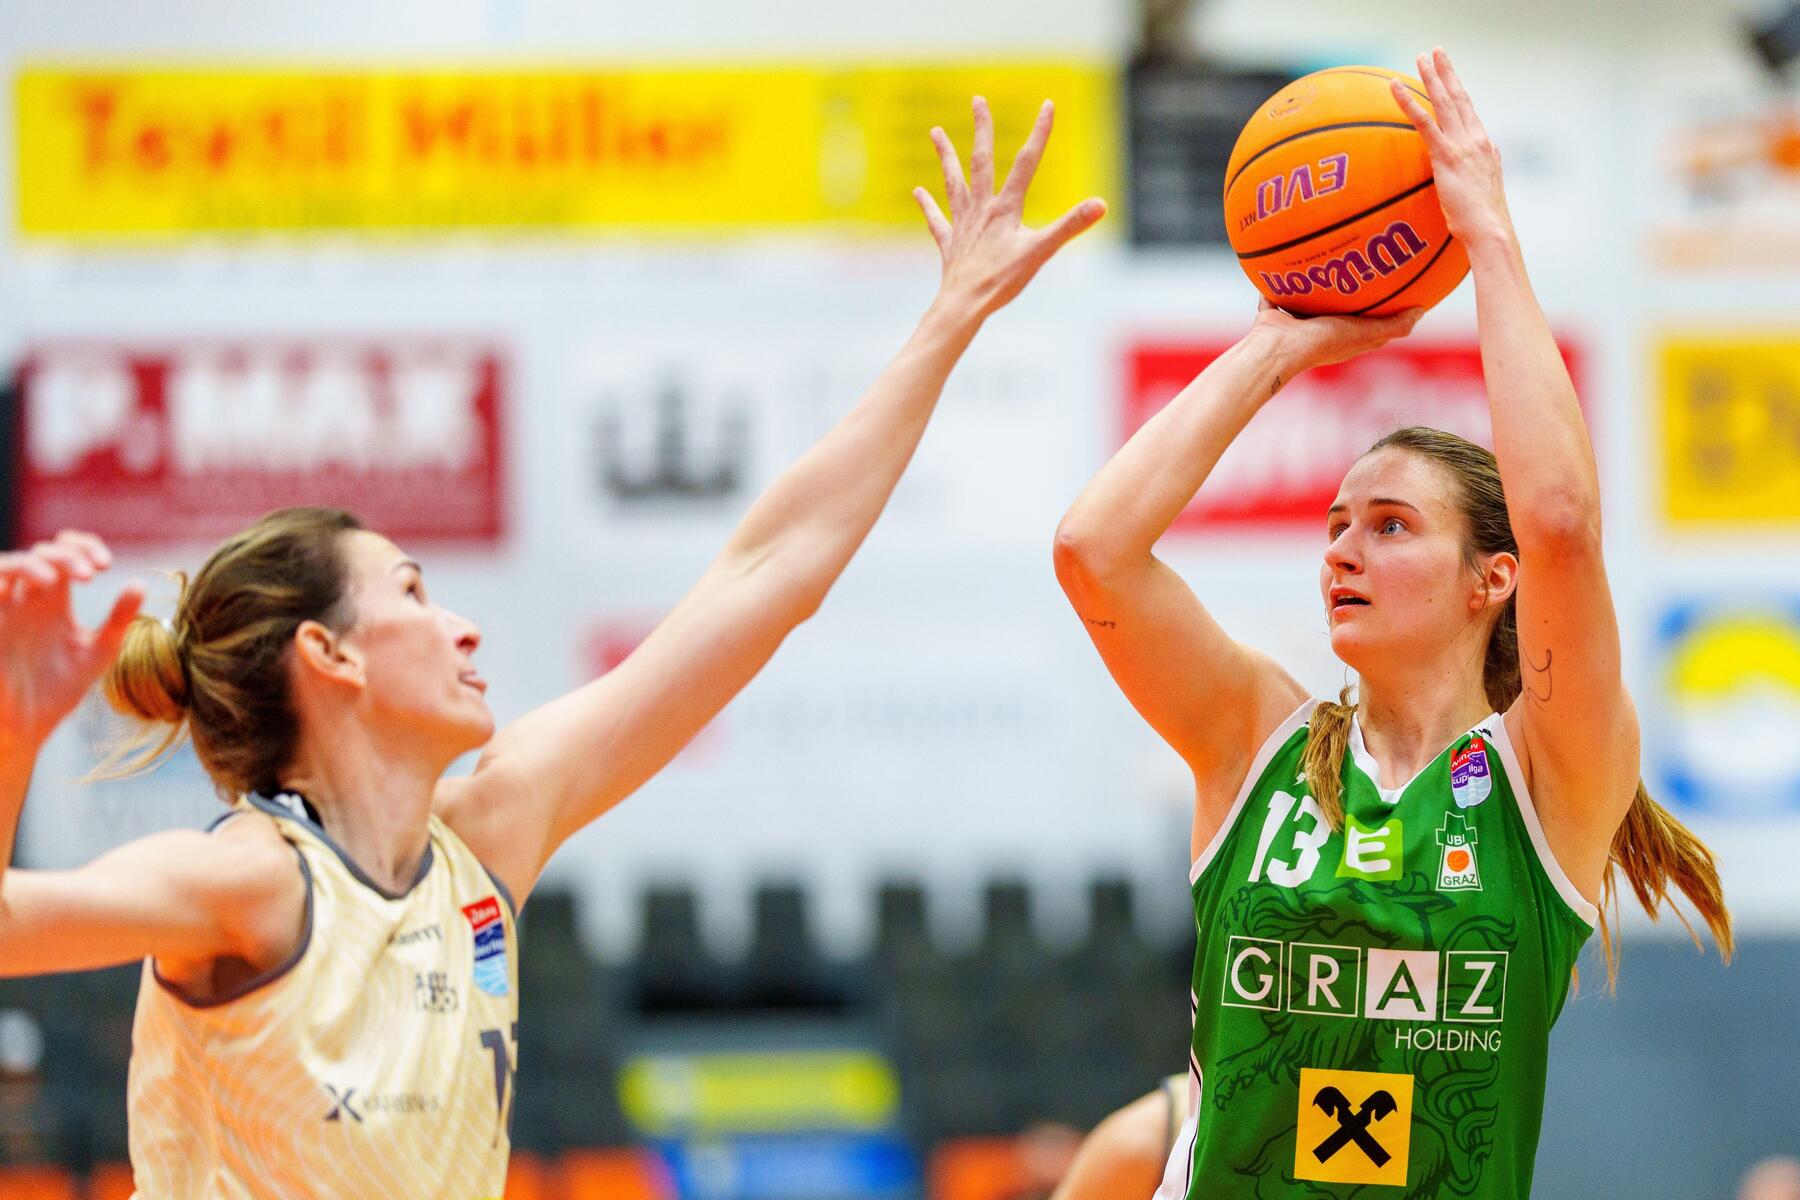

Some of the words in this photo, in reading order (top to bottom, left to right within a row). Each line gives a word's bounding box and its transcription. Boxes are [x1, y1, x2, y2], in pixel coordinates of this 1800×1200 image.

[1257, 153, 1349, 220] EVO
[1260, 221, 1429, 297] Wilson
[1248, 790, 1331, 888] 13
[1446, 832, 1466, 846] UBI
[1443, 873, 1477, 886] GRAZ
[1230, 946, 1497, 1014] GRAZ
[1395, 1028, 1501, 1052] HOLDING
